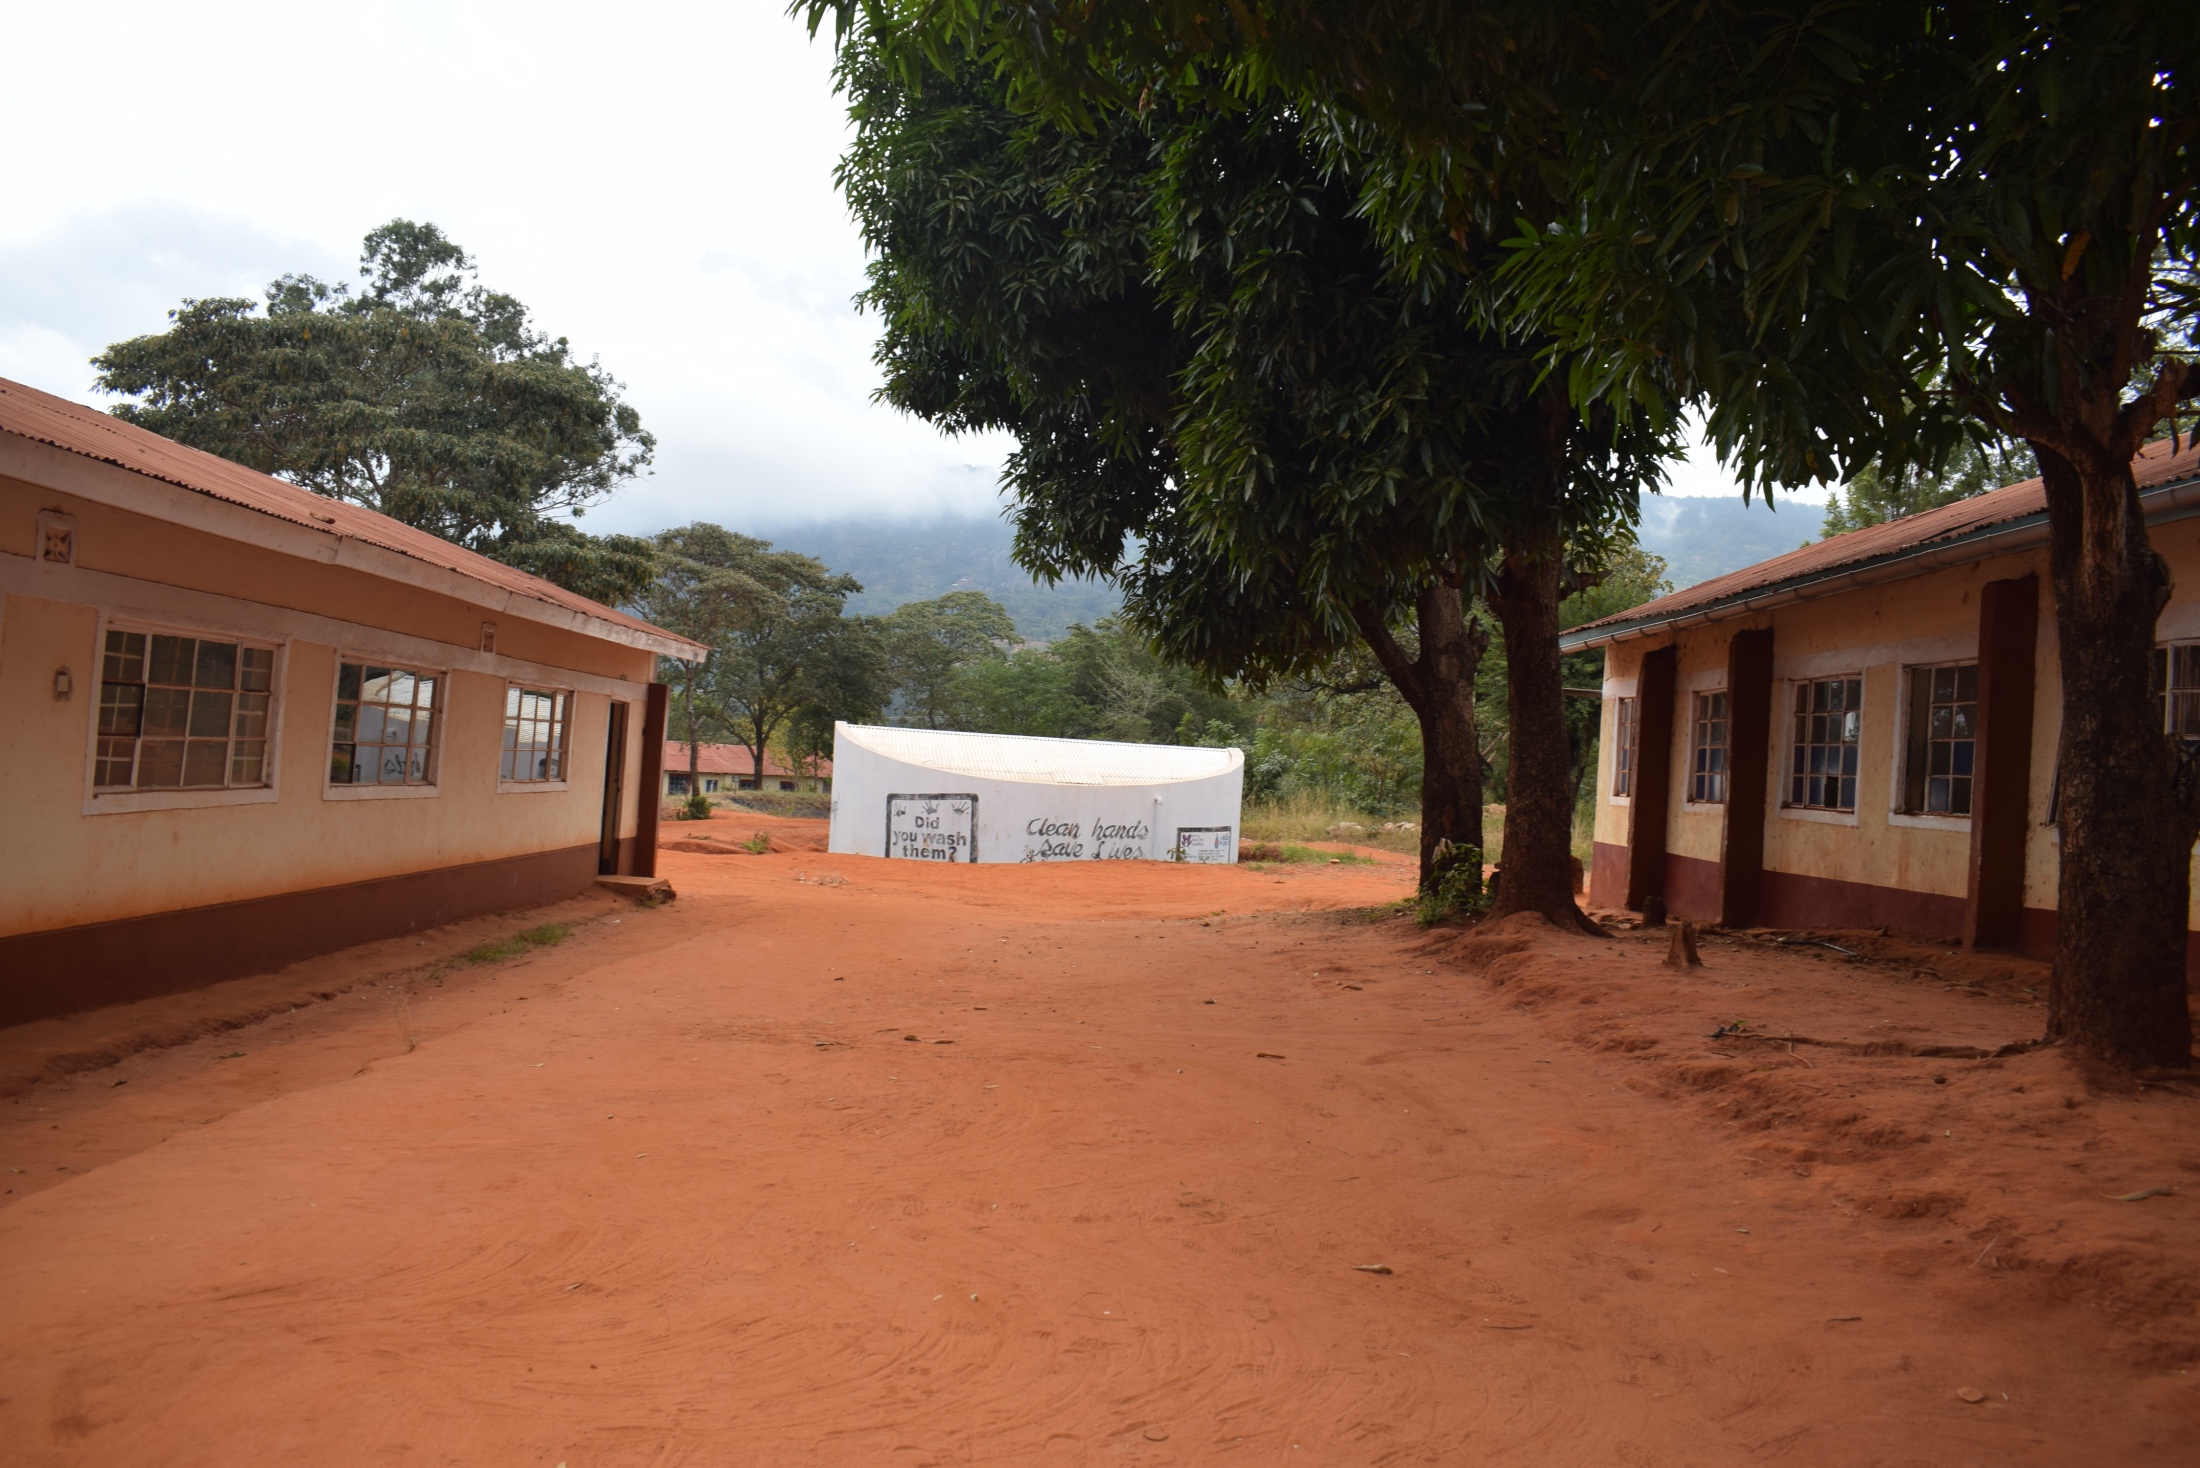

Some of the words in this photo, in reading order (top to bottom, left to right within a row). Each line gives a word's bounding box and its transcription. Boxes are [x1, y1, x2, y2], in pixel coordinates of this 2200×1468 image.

[914, 815, 940, 829] Did
[1026, 817, 1081, 839] Clean
[1091, 817, 1149, 841] hands
[892, 830, 918, 846] you
[921, 831, 967, 846] wash
[902, 843, 958, 863] them?
